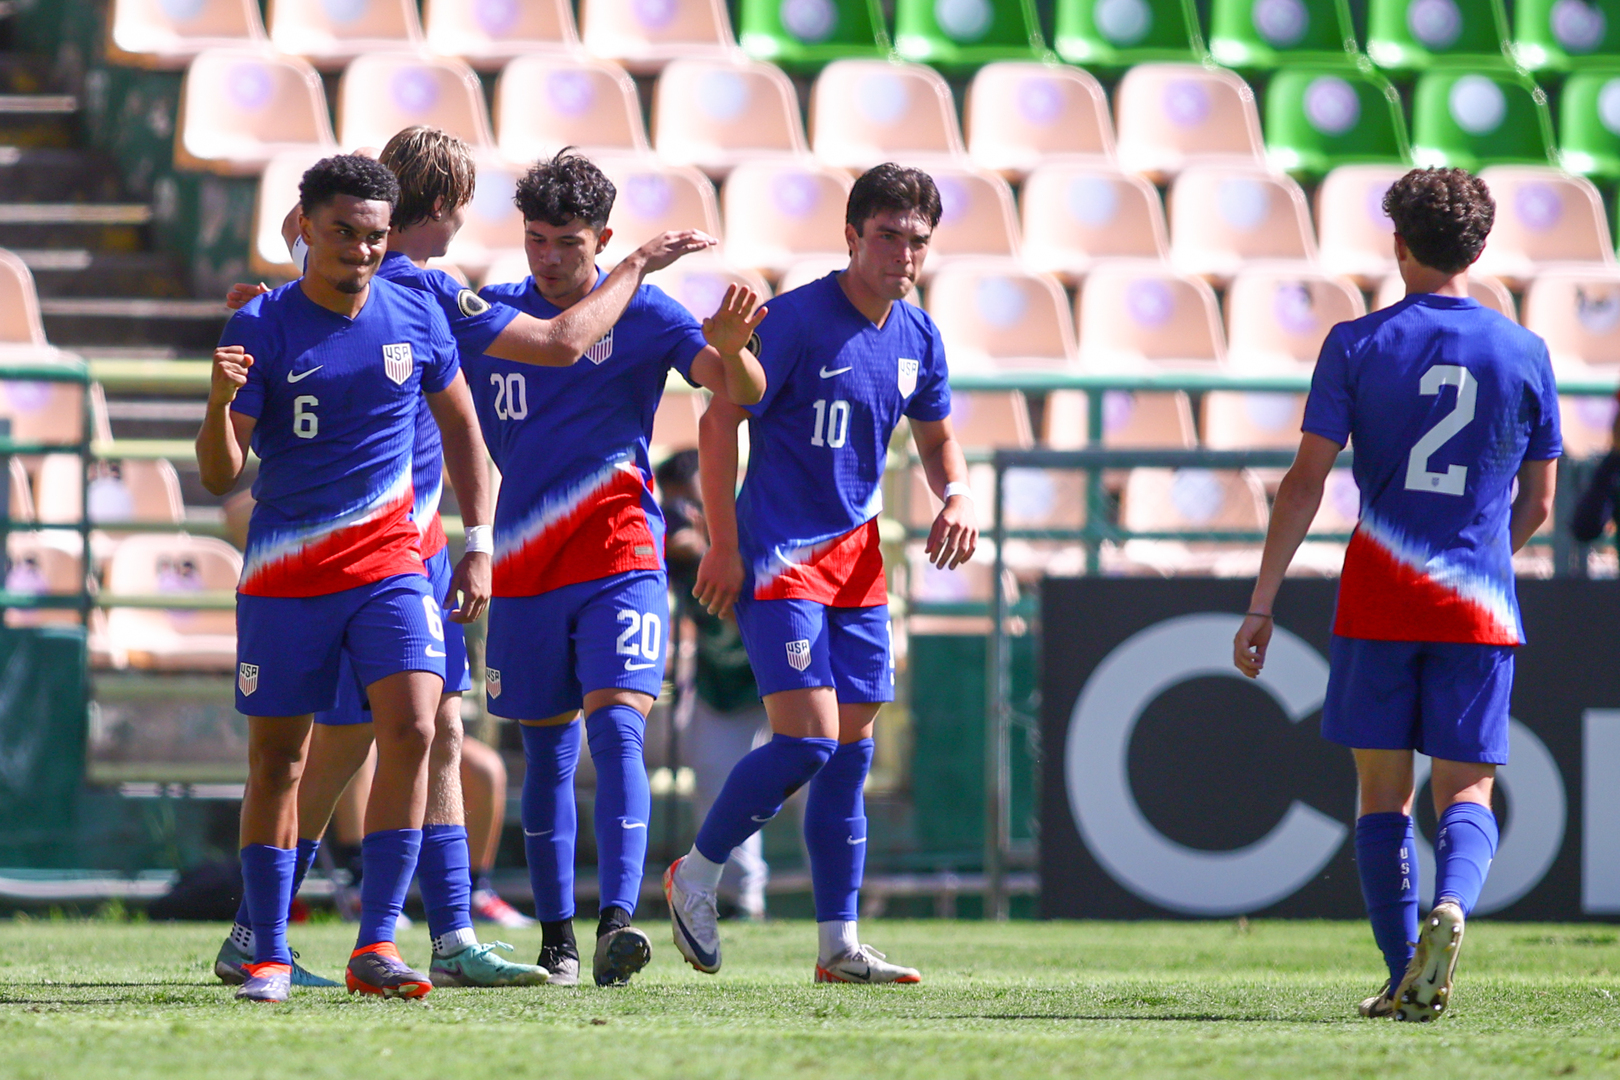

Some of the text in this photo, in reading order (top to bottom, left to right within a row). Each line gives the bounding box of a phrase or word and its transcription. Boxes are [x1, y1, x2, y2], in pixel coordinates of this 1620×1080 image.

[385, 346, 409, 361] USA
[900, 361, 917, 376] USA
[293, 395, 319, 439] 6
[489, 372, 528, 421] 20
[810, 398, 851, 449] 10
[1404, 364, 1479, 496] 2
[422, 594, 445, 642] 6
[616, 609, 661, 661] 20
[787, 642, 808, 654] USA
[240, 664, 258, 678] USA
[486, 670, 500, 682] USA
[1063, 611, 1620, 916] Co
[1438, 827, 1447, 850] SA
[1399, 847, 1411, 890] USA
